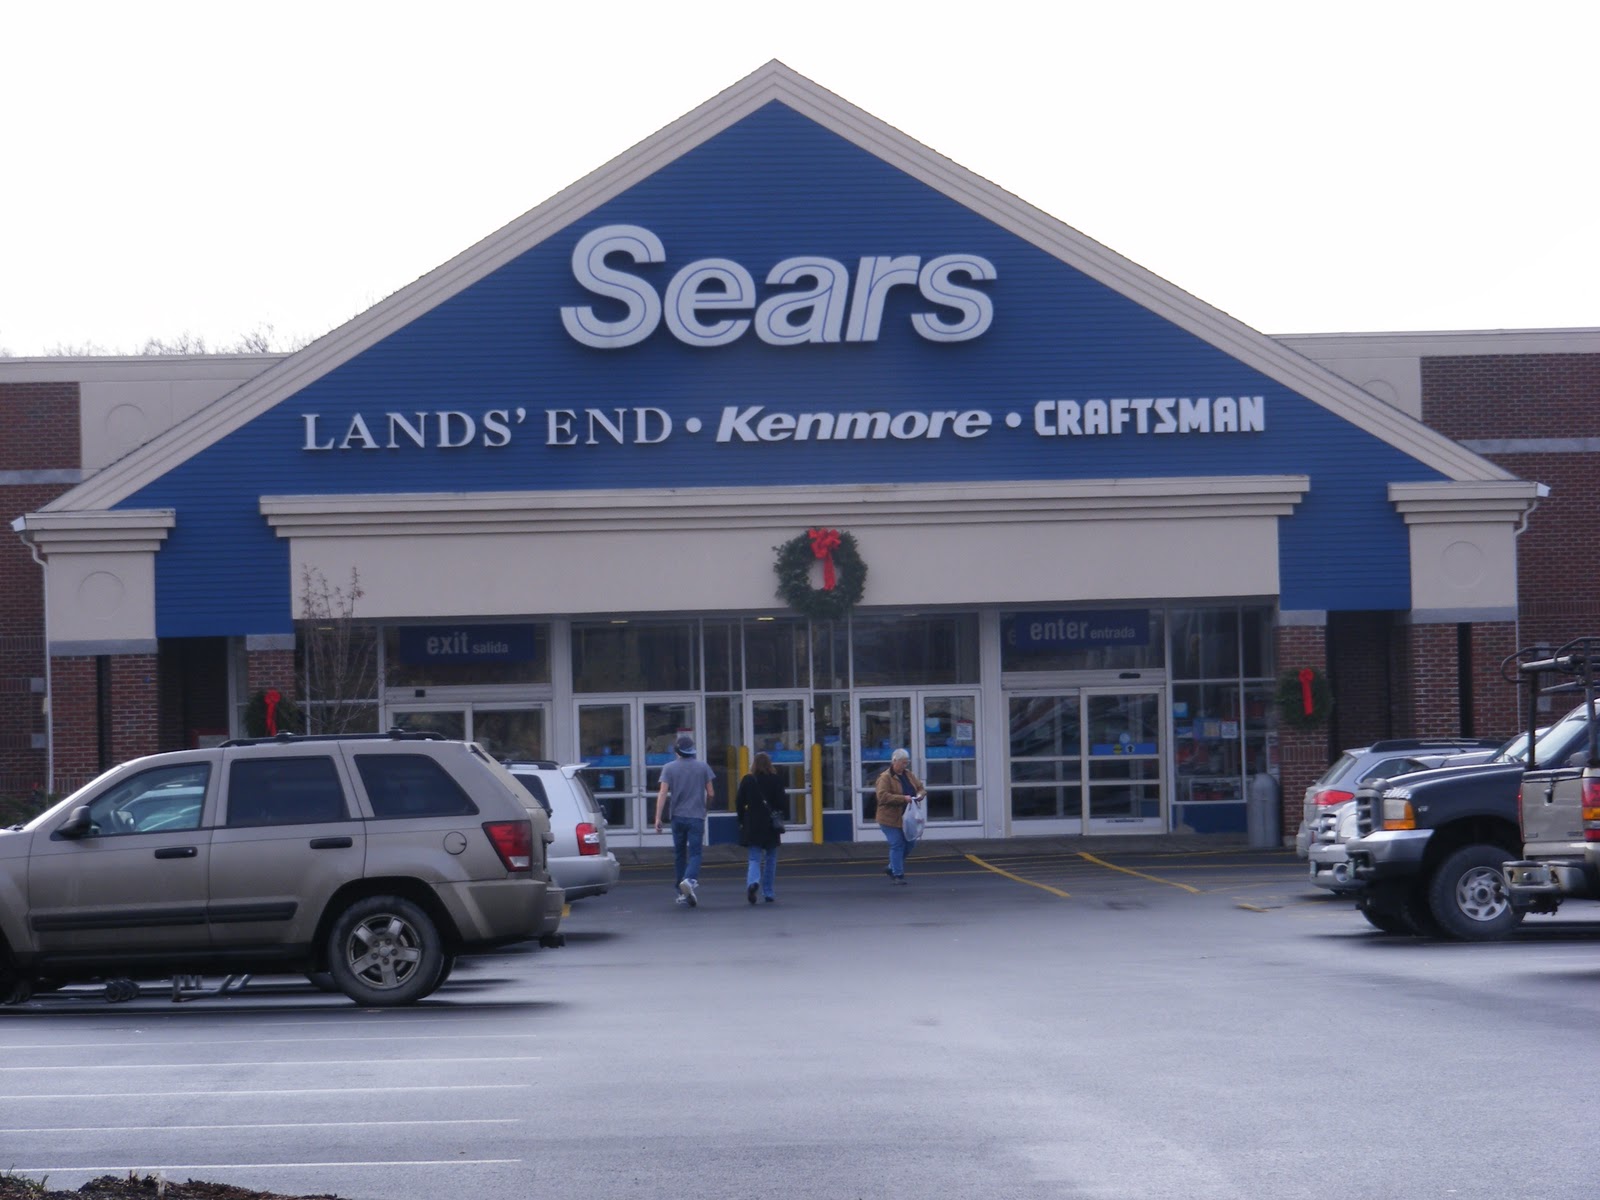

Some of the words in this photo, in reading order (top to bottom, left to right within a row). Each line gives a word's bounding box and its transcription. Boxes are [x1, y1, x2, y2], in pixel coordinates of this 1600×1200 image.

[561, 224, 997, 348] Sears
[546, 407, 673, 445] END
[716, 405, 992, 442] Kenmore
[1034, 396, 1265, 436] CRAFTSMAN
[427, 631, 468, 654] exit
[472, 641, 509, 654] salida
[1030, 619, 1088, 640] enter
[1090, 626, 1136, 639] entrada
